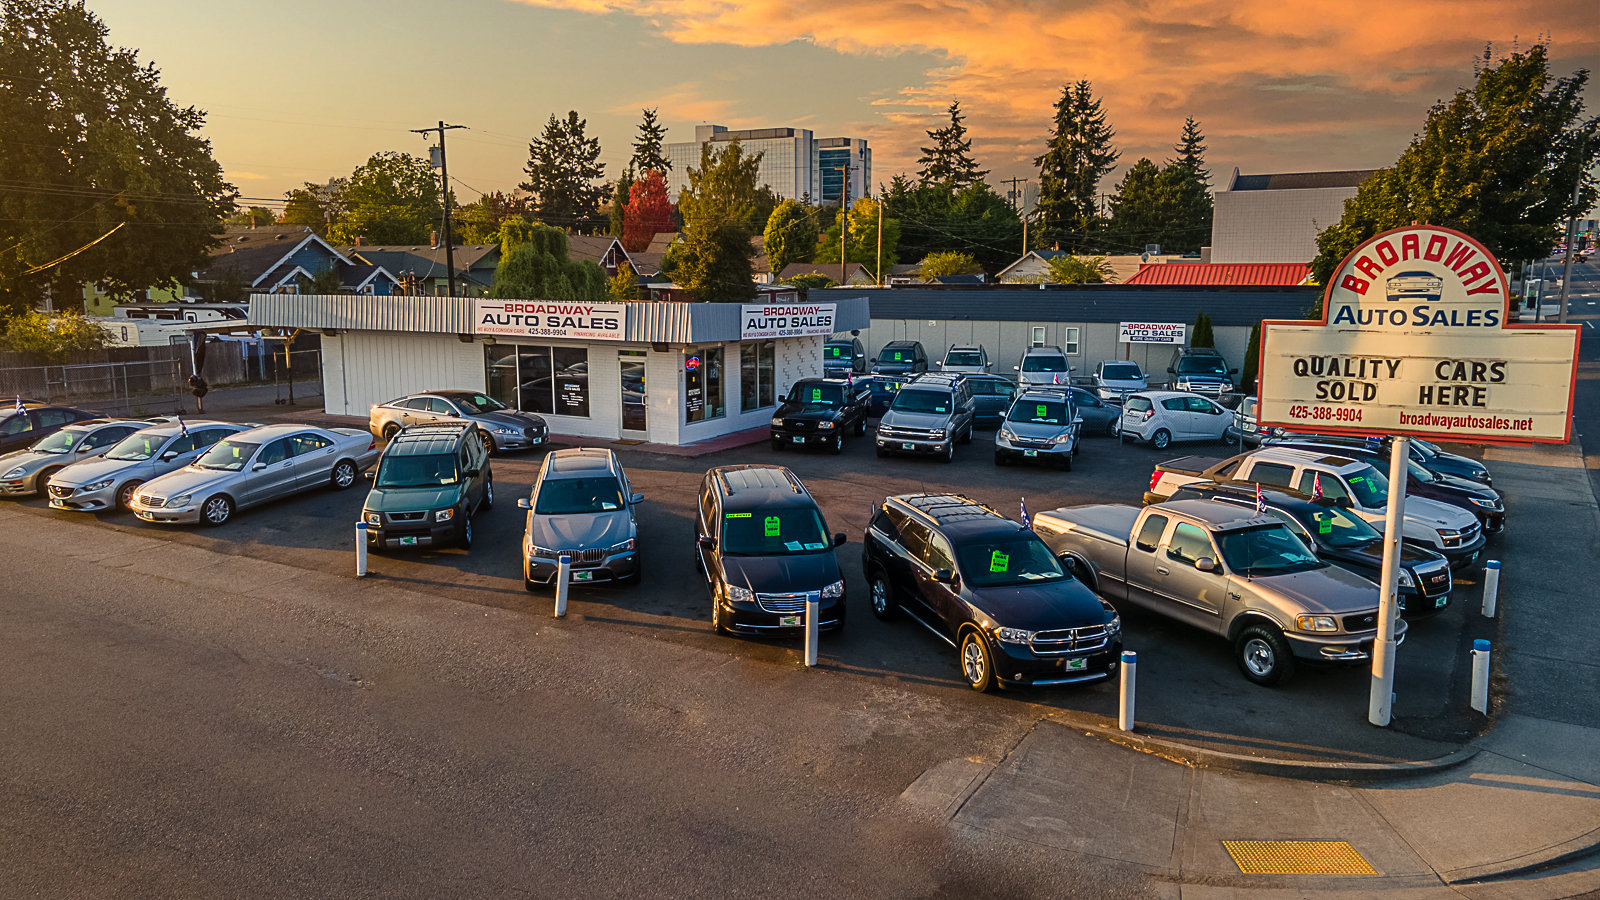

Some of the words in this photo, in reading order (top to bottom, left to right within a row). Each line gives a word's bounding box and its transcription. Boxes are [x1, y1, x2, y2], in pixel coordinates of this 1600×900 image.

[1341, 233, 1500, 296] BROADWAY
[505, 303, 594, 316] BROADWAY
[763, 306, 820, 317] BROADWAY
[1333, 305, 1407, 325] AUTO
[1412, 305, 1499, 327] SALES
[481, 313, 540, 327] AUTO
[547, 315, 619, 330] SALES
[746, 317, 787, 330] AUTO
[790, 316, 832, 328] SALES
[528, 328, 567, 336] 425-388-9904
[1293, 356, 1402, 379] QUALITY
[1435, 360, 1506, 383] CARS
[1315, 380, 1377, 401] SOLD
[1419, 385, 1487, 407] HERE
[1289, 405, 1362, 422] 425-388-9904
[1400, 410, 1533, 431] broadwayautosales.net
